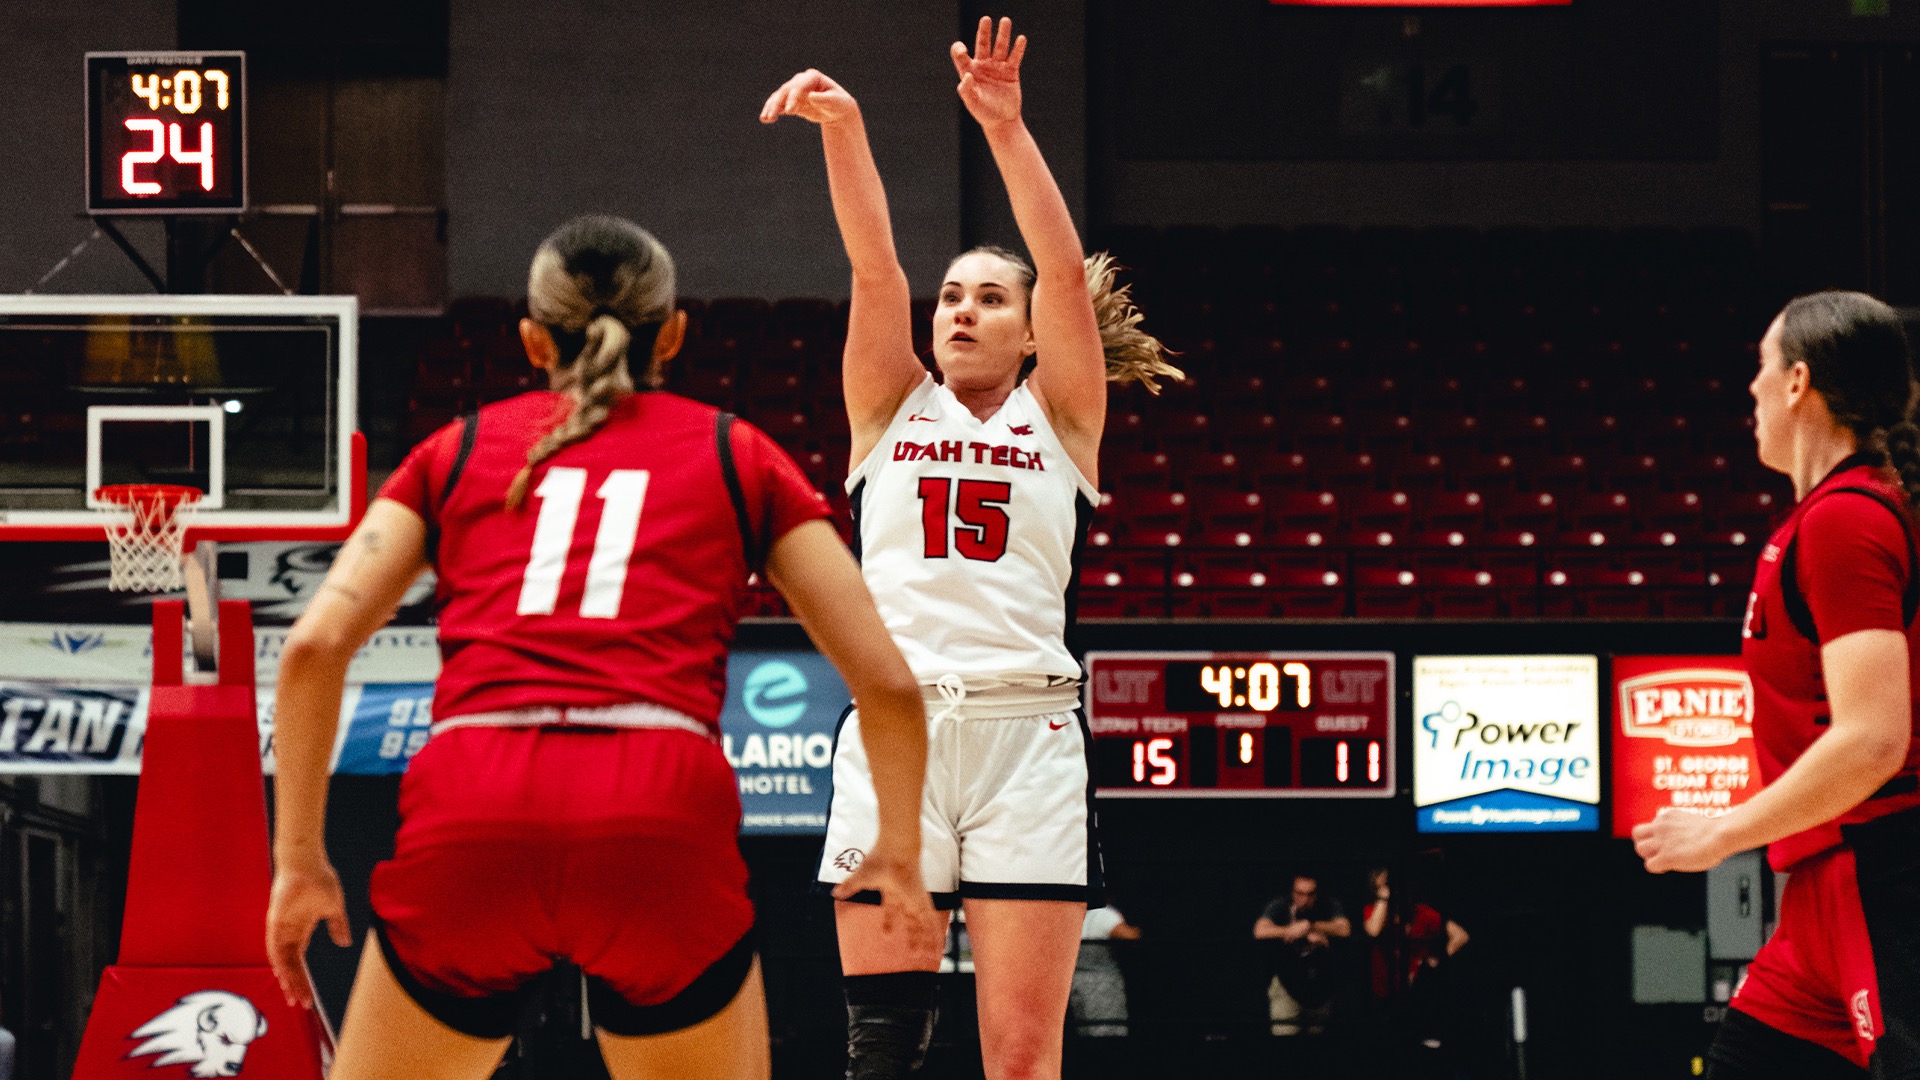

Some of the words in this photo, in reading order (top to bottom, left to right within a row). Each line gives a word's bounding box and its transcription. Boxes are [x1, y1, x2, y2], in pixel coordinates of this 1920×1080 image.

[131, 70, 229, 114] 4:07
[121, 118, 214, 195] 24
[893, 440, 962, 463] UTAH
[968, 441, 1046, 472] TECH
[917, 476, 1012, 562] 15
[516, 465, 651, 620] 11
[1201, 662, 1311, 712] 4:07
[1240, 732, 1253, 764] 1
[1454, 712, 1581, 749] Power
[723, 733, 834, 769] LARIO
[1132, 738, 1177, 786] 15
[1336, 740, 1381, 783] 11
[1460, 750, 1590, 786] Image
[1680, 755, 1749, 774] GEORGE
[739, 773, 814, 795] HOTEL
[1653, 774, 1707, 790] CEDAR
[1711, 774, 1749, 789] CITY
[1672, 790, 1731, 806] BEAVER
